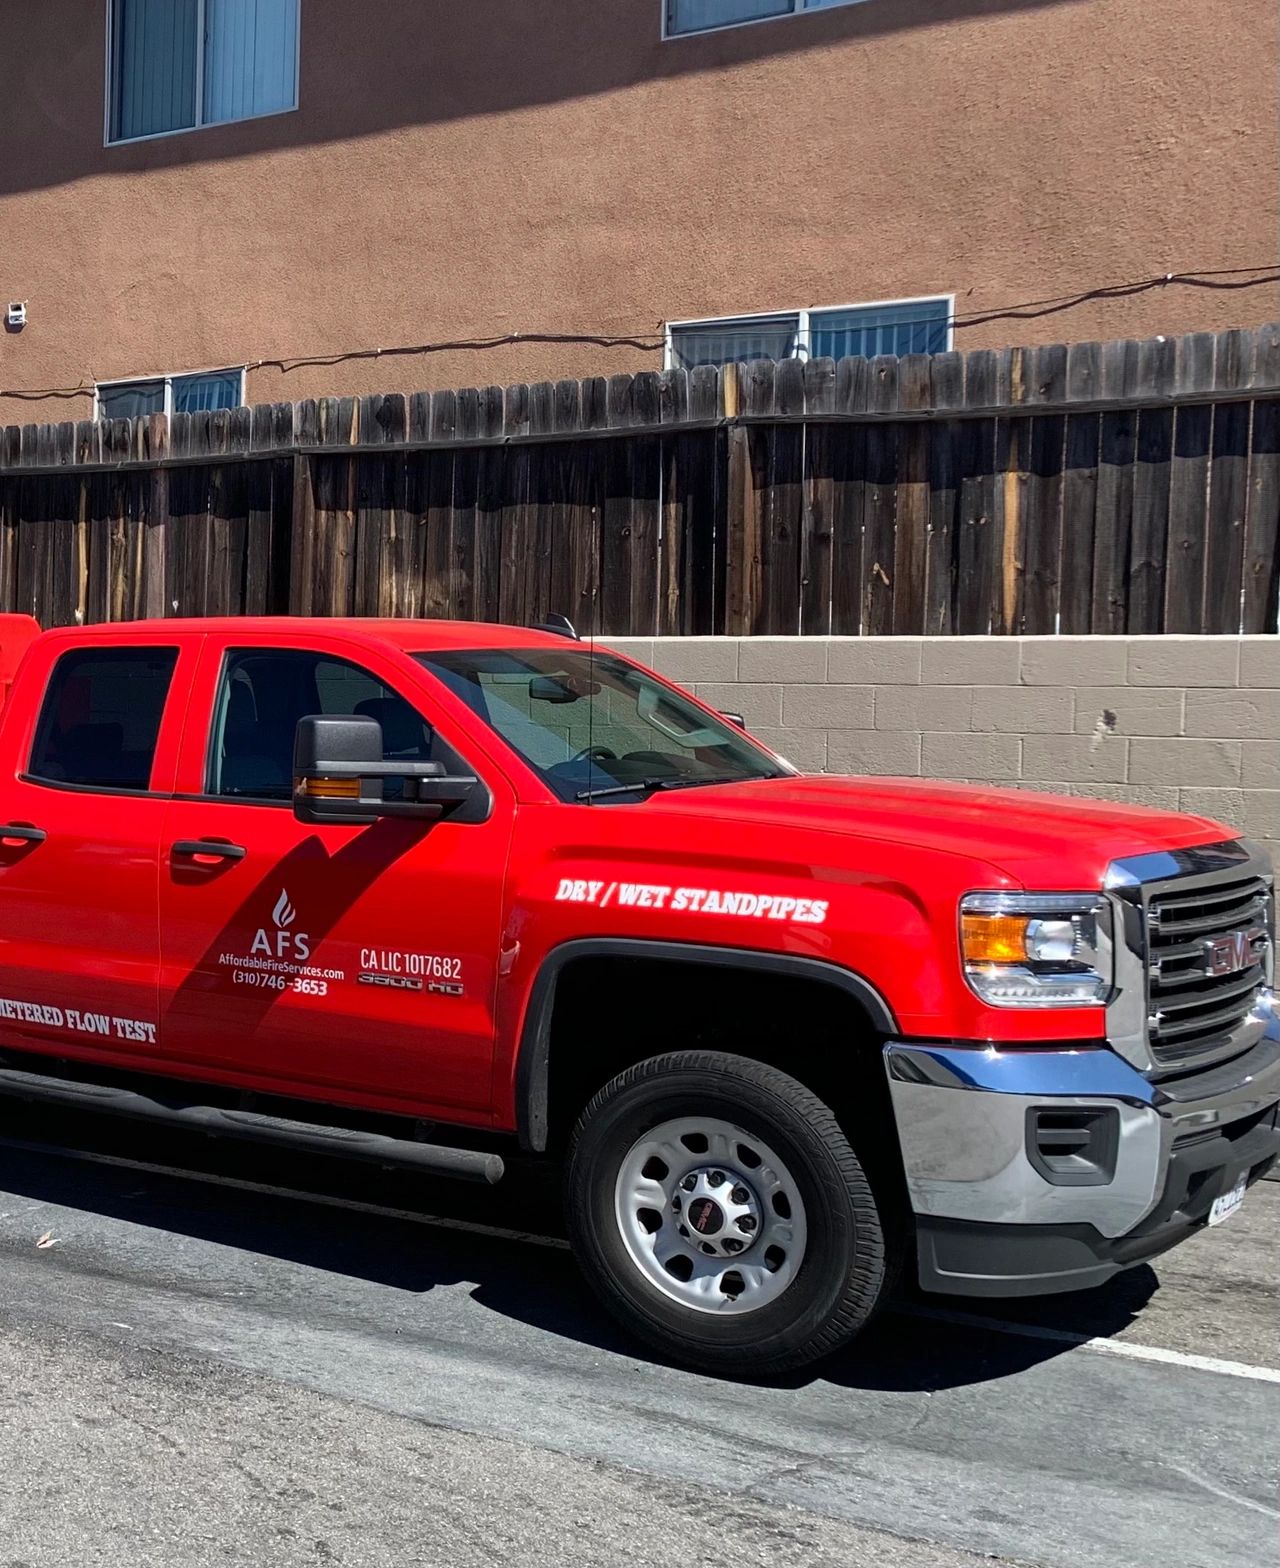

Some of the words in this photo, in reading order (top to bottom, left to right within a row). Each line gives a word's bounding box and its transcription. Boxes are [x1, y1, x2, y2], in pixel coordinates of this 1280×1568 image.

[555, 878, 603, 902] DRY
[618, 882, 671, 909] WET
[670, 887, 829, 925] STANDPIPES
[250, 928, 310, 960] AFS
[1205, 928, 1270, 977] GMC
[218, 953, 345, 980] AffordableFireServices.com
[360, 948, 379, 970] CA
[381, 951, 402, 973] LIC
[403, 953, 462, 979] 1017682
[428, 980, 464, 995] HD
[65, 1009, 110, 1036] FLOW
[112, 1017, 156, 1044] TEST
